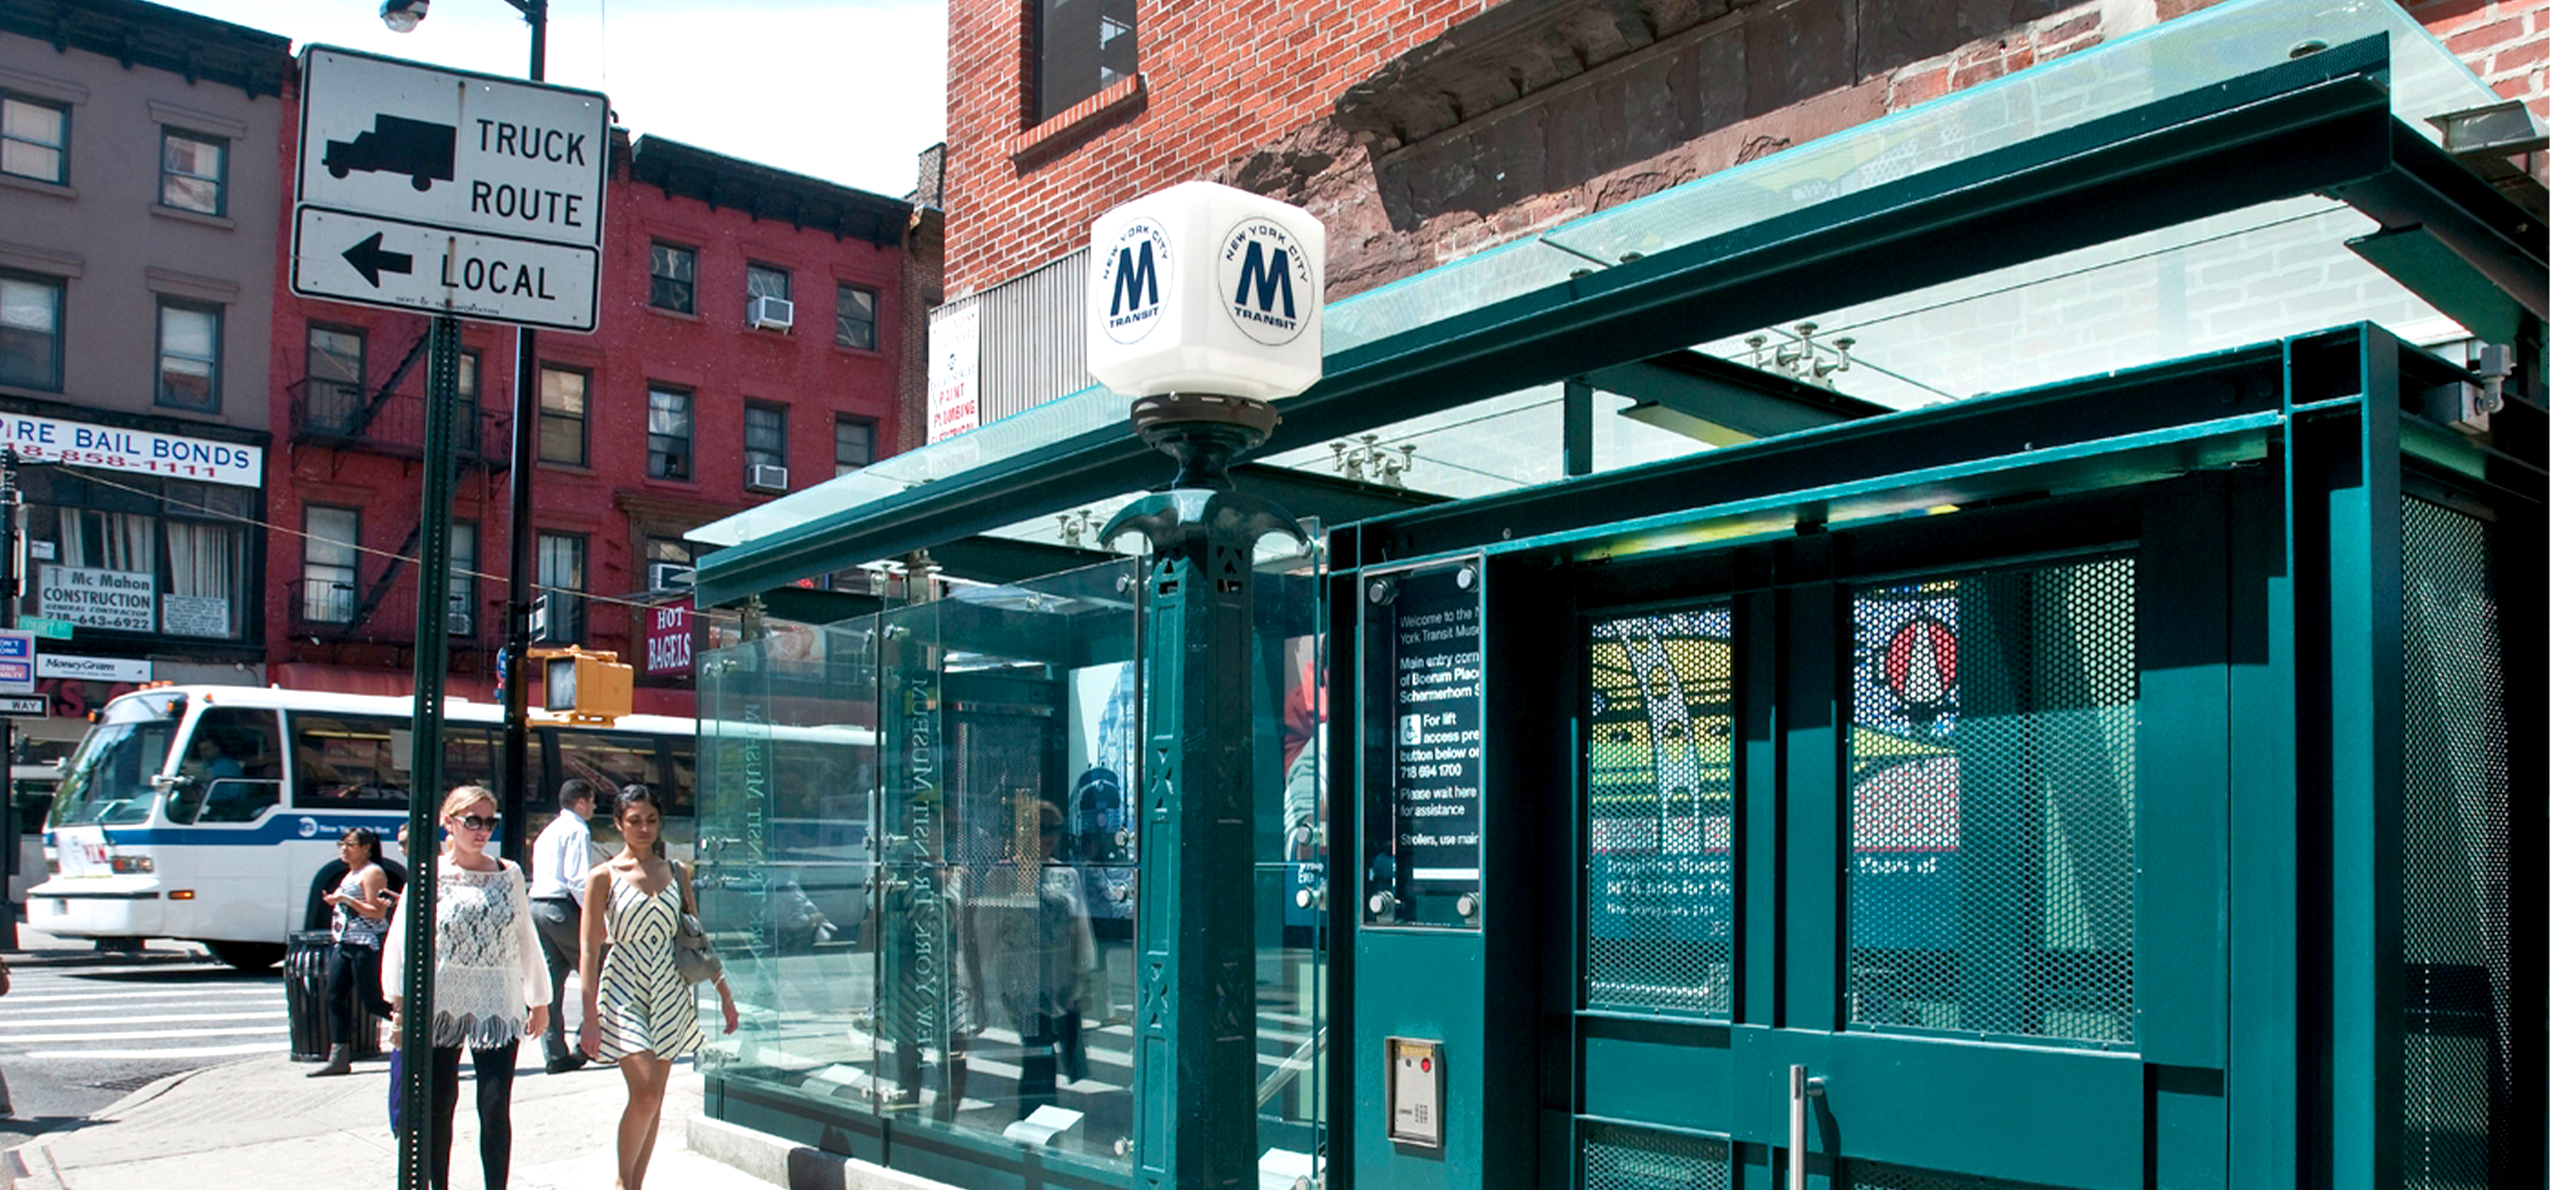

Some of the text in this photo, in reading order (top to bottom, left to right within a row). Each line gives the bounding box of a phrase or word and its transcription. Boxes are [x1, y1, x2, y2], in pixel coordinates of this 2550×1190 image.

[476, 118, 586, 167] TRUCK
[471, 179, 584, 228] ROUTE
[1103, 224, 1169, 280] NEW YORK CITY
[1226, 225, 1309, 284] NEW YORK CITY
[441, 254, 556, 301] LOCAL
[1110, 239, 1159, 317] M
[1235, 239, 1297, 320] M
[1109, 306, 1159, 329] TRANSIT
[1234, 306, 1297, 331] TRANSIT
[0, 418, 250, 469] IRE BAIL BONDS
[71, 572, 150, 591] Mc Mahon
[43, 587, 150, 609] CONSTRUCTION
[44, 603, 149, 617] GENERAL CONTRACTOR
[657, 606, 685, 630] HOT
[1400, 613, 1443, 628] Welcome
[1444, 610, 1454, 622] to
[1456, 607, 1472, 620] the
[1400, 631, 1421, 645] York
[1422, 626, 1454, 642] Transit
[648, 632, 692, 671] BAGELS
[1400, 656, 1424, 670] Main
[1426, 653, 1454, 668] entry
[45, 658, 115, 671] MoneyGram
[1400, 672, 1410, 687] of
[1412, 671, 1452, 686] Boerum
[12, 701, 37, 712] WAY
[1423, 711, 1457, 727] For lift
[1423, 731, 1460, 744] access
[1400, 749, 1433, 762] button
[1434, 747, 1467, 760] below
[1438, 762, 1462, 777] 1700
[1400, 784, 1477, 800] Please wait here
[1400, 802, 1465, 817] for assistance
[1400, 832, 1438, 847] Strollers,
[1440, 834, 1456, 846] use
